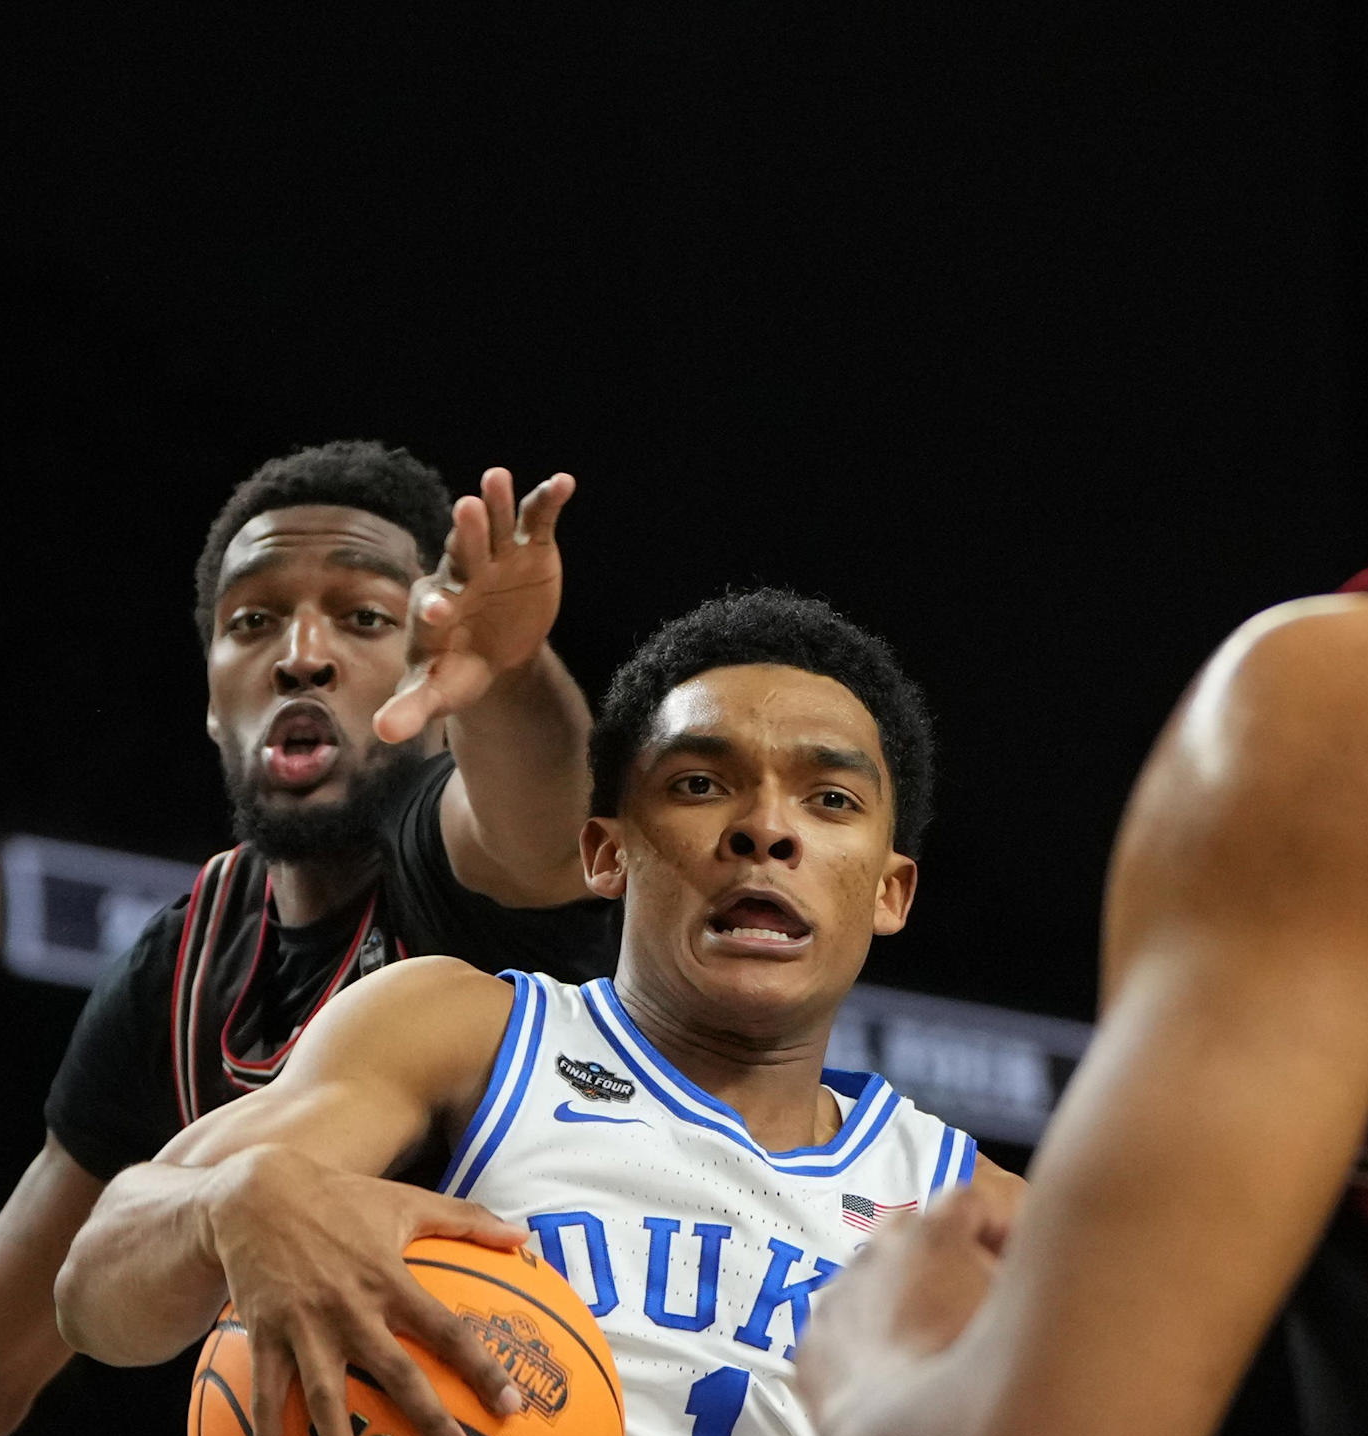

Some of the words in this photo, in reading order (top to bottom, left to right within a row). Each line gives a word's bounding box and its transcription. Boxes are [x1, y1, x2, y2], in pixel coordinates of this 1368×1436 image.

[560, 1060, 593, 1083] FINAL
[594, 1077, 632, 1095] FOUR
[527, 1210, 847, 1361] DUK
